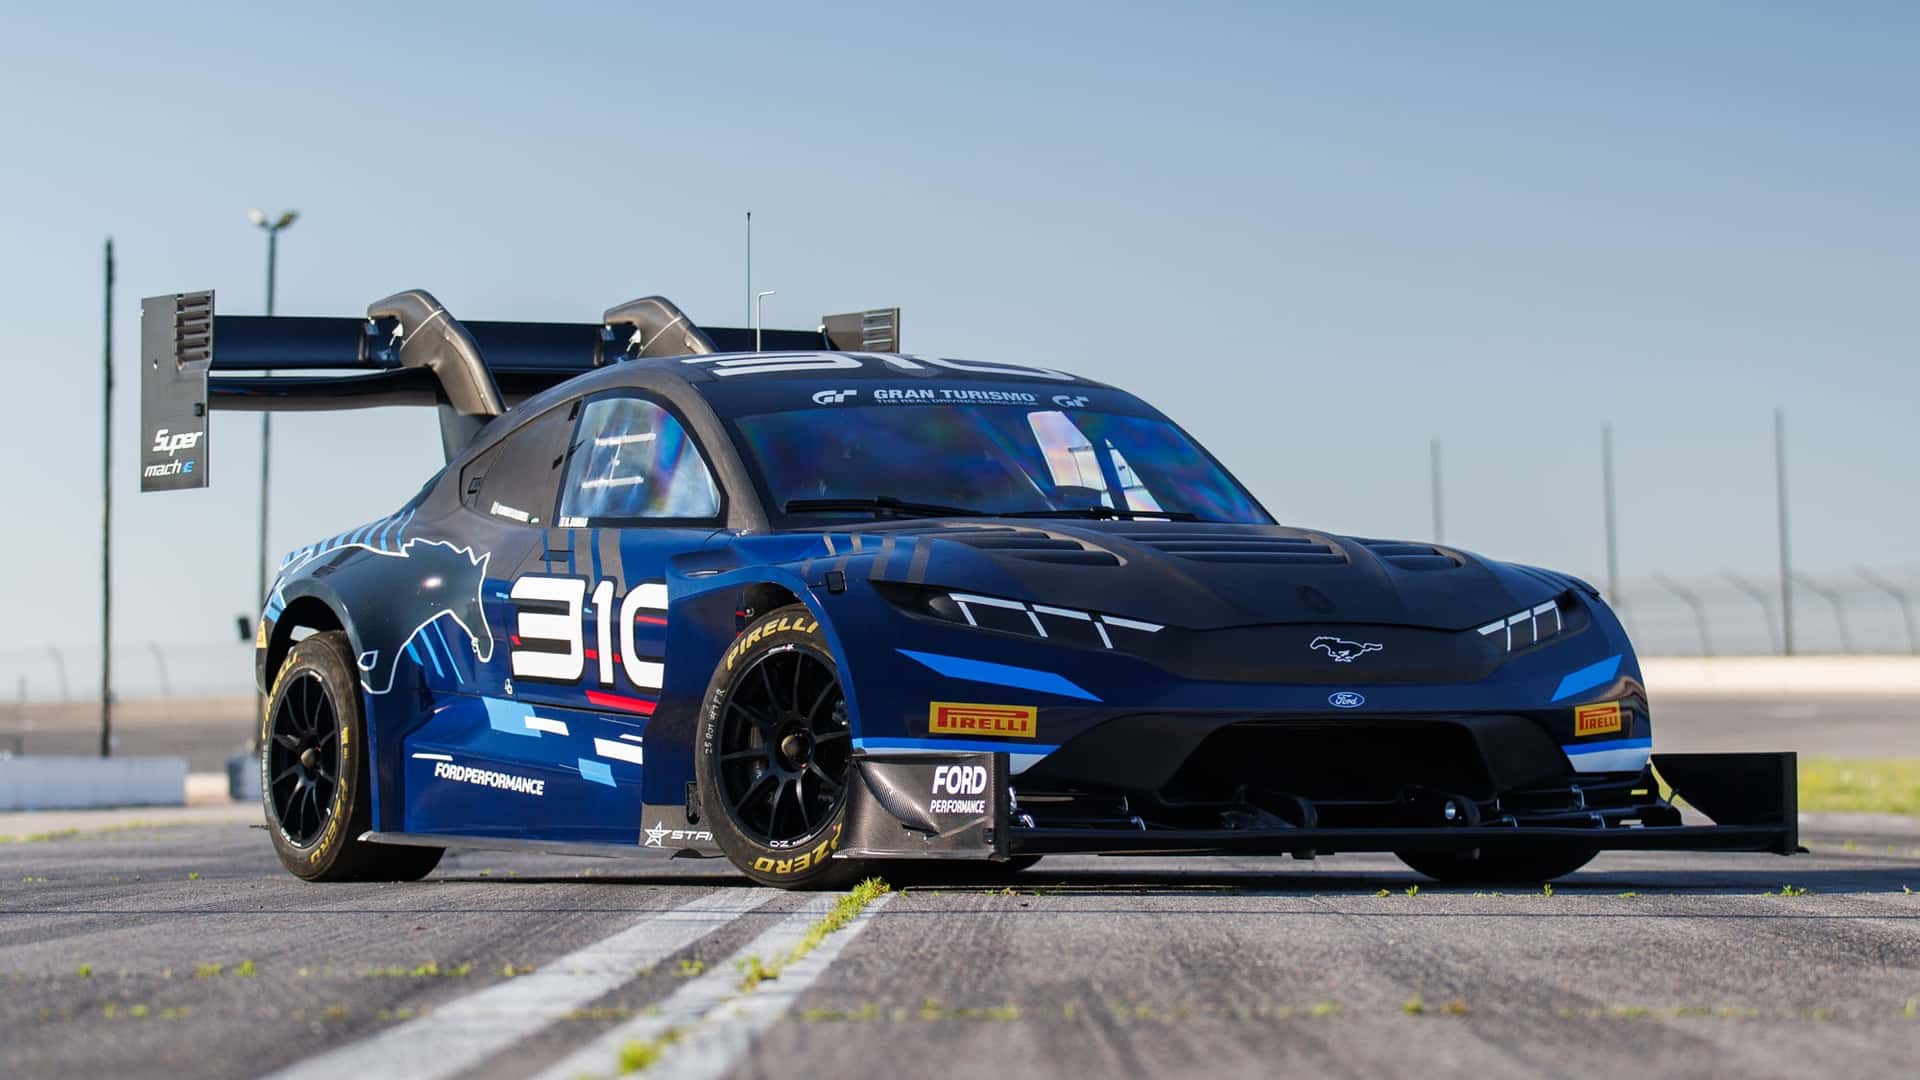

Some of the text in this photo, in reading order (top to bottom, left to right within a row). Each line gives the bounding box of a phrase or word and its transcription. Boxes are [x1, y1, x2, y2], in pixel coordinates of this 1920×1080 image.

[873, 389, 1036, 402] GRAN TURISMO
[152, 429, 203, 456] Super
[727, 617, 819, 671] PIRELLI
[938, 706, 1030, 732] PIRELLI
[1579, 706, 1617, 731] PIRELLI
[932, 766, 988, 795] FORD
[929, 799, 985, 813] PERFORMANCE
[753, 840, 830, 874] ZERO
